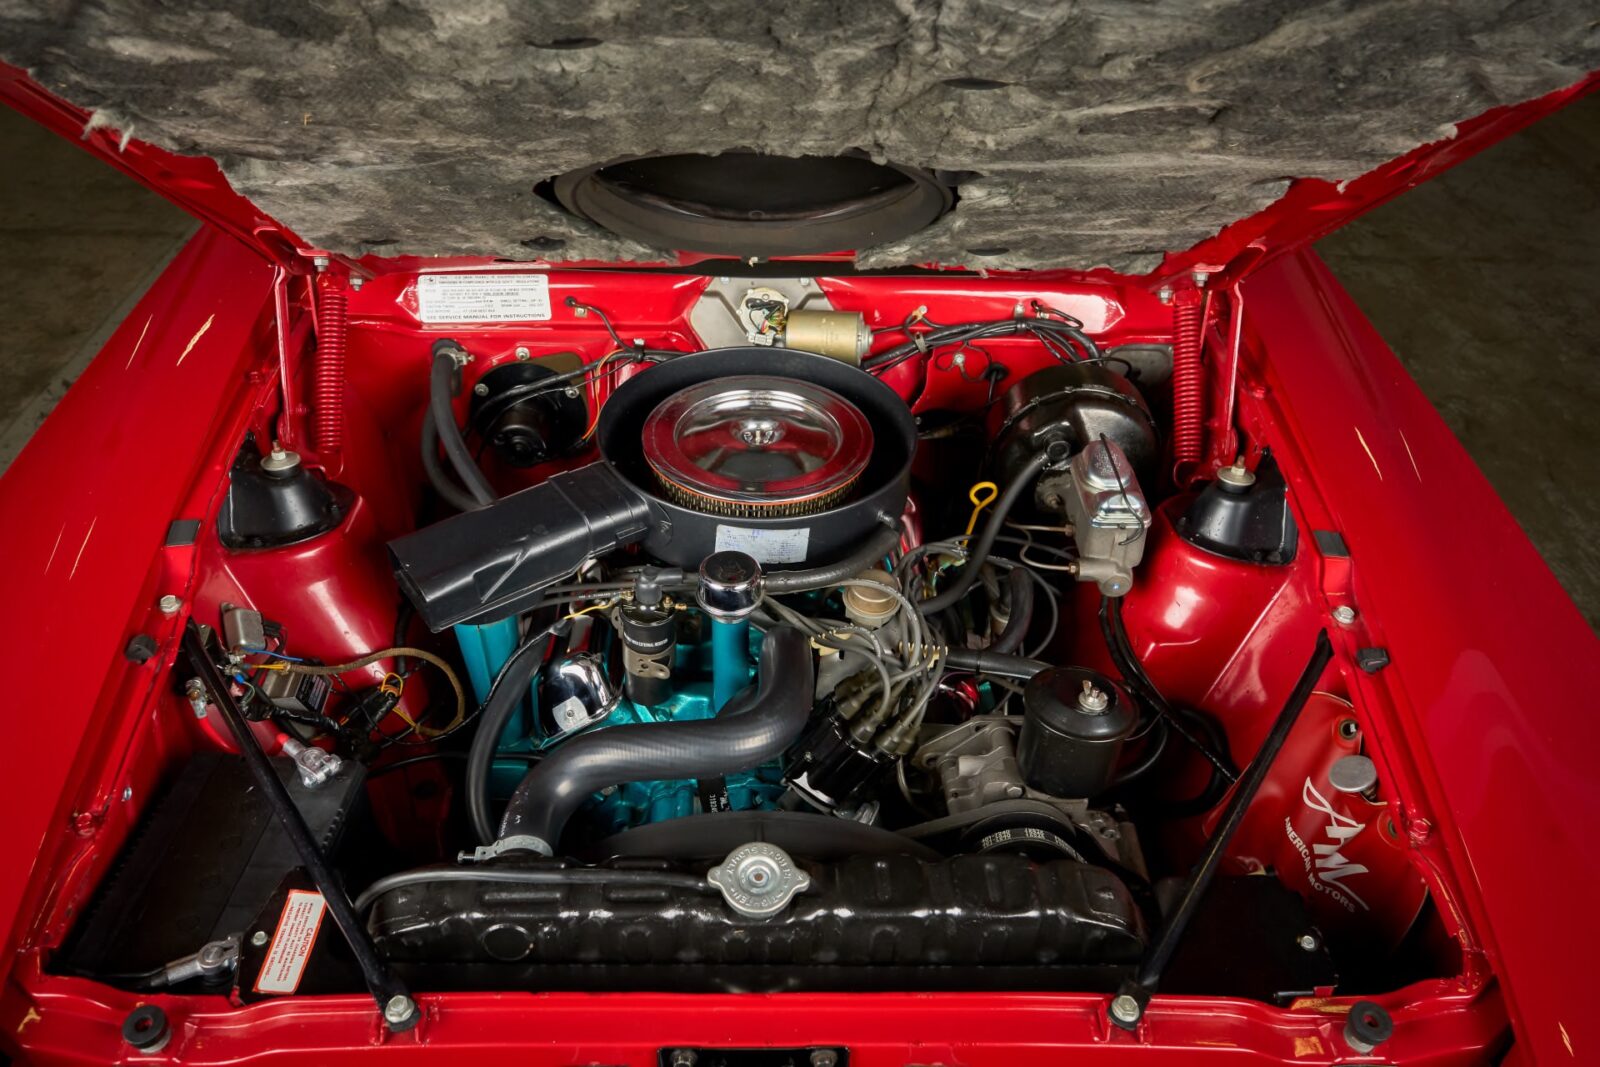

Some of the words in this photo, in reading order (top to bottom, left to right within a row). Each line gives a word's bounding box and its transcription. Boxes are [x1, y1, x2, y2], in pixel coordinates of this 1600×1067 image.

[1284, 816, 1313, 872] AMERICAN
[1307, 872, 1355, 913] MOTORS
[299, 927, 313, 956] CAUTION
